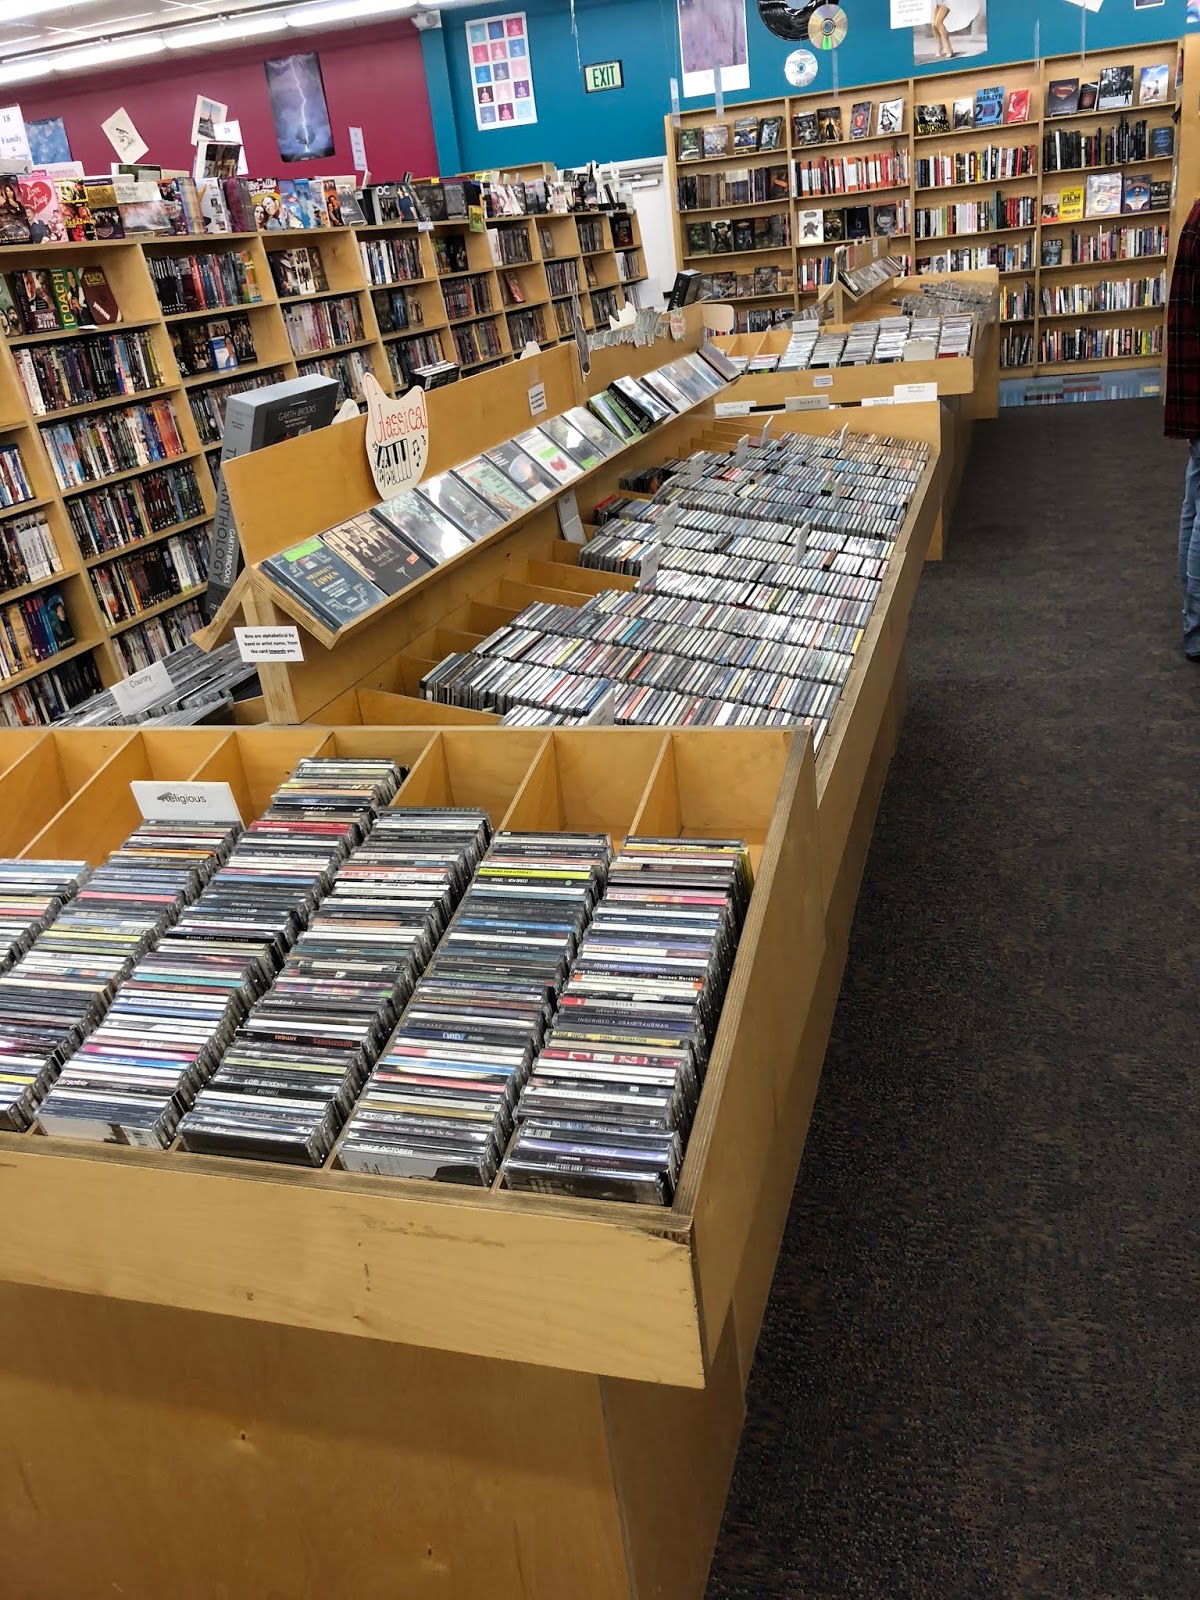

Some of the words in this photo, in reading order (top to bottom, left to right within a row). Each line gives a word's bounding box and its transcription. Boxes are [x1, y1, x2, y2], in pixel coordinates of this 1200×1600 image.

[592, 65, 615, 88] EXIT
[983, 87, 999, 95] ELVIS
[976, 93, 1003, 103] MARILYN
[2, 114, 11, 123] 18
[917, 122, 950, 133] WATCHMEN
[1, 136, 22, 145] Family
[27, 186, 41, 200] Love
[376, 186, 390, 196] OC
[33, 194, 48, 209] Lucy
[52, 272, 75, 324] COACH
[278, 408, 297, 421] GARTH
[297, 404, 317, 418] BROOKS
[365, 374, 428, 444] Classical
[213, 482, 231, 581] ANTHOLOGY
[226, 528, 236, 555] GARTH
[223, 555, 234, 584] BROOKS
[130, 675, 152, 688] Country
[161, 792, 207, 805] Religious
[380, 1146, 414, 1155] OCTOBER
